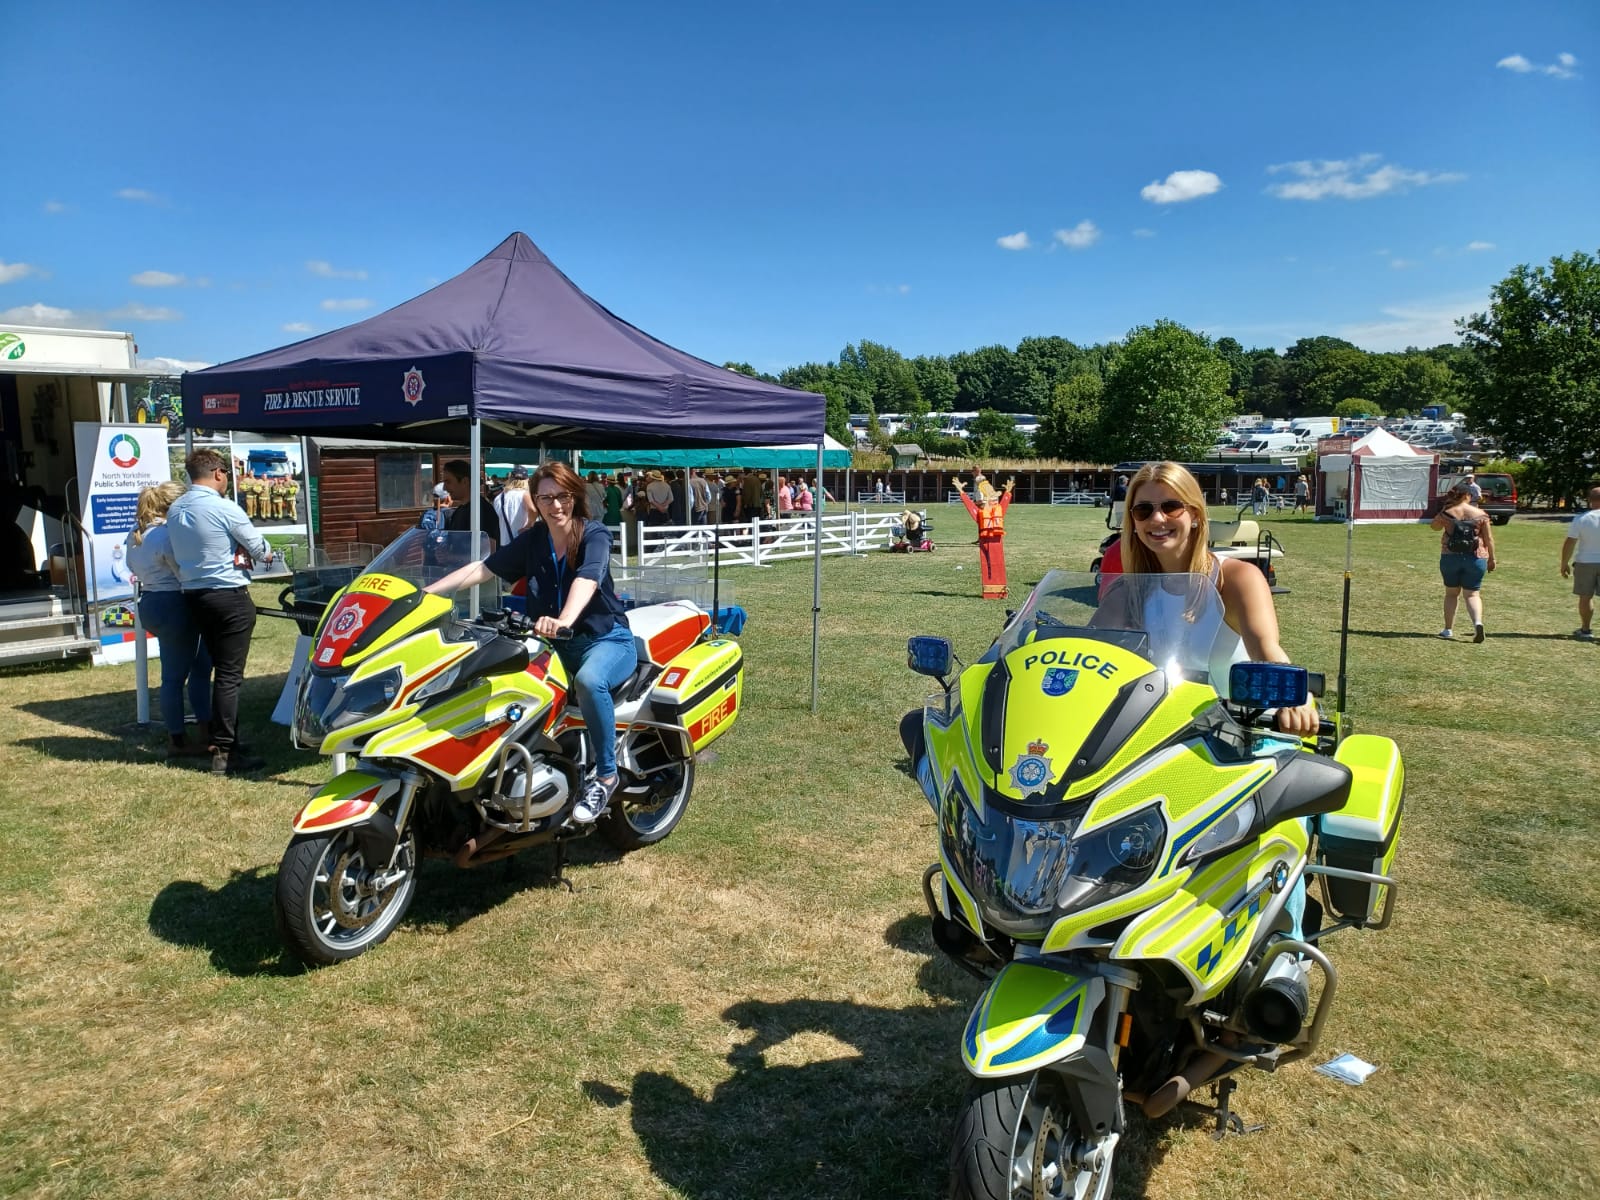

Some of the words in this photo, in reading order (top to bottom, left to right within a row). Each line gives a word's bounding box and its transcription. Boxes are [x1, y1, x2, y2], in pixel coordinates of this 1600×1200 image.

[264, 394, 282, 411] FIRE
[283, 393, 292, 409] &
[293, 390, 324, 408] RESCUE
[325, 388, 361, 407] SERVICE
[94, 480, 115, 488] Public
[115, 480, 136, 488] Safety
[136, 479, 160, 487] Service
[357, 577, 392, 591] FIRE
[1024, 651, 1119, 680] POLICE
[701, 700, 728, 736] FIRE
